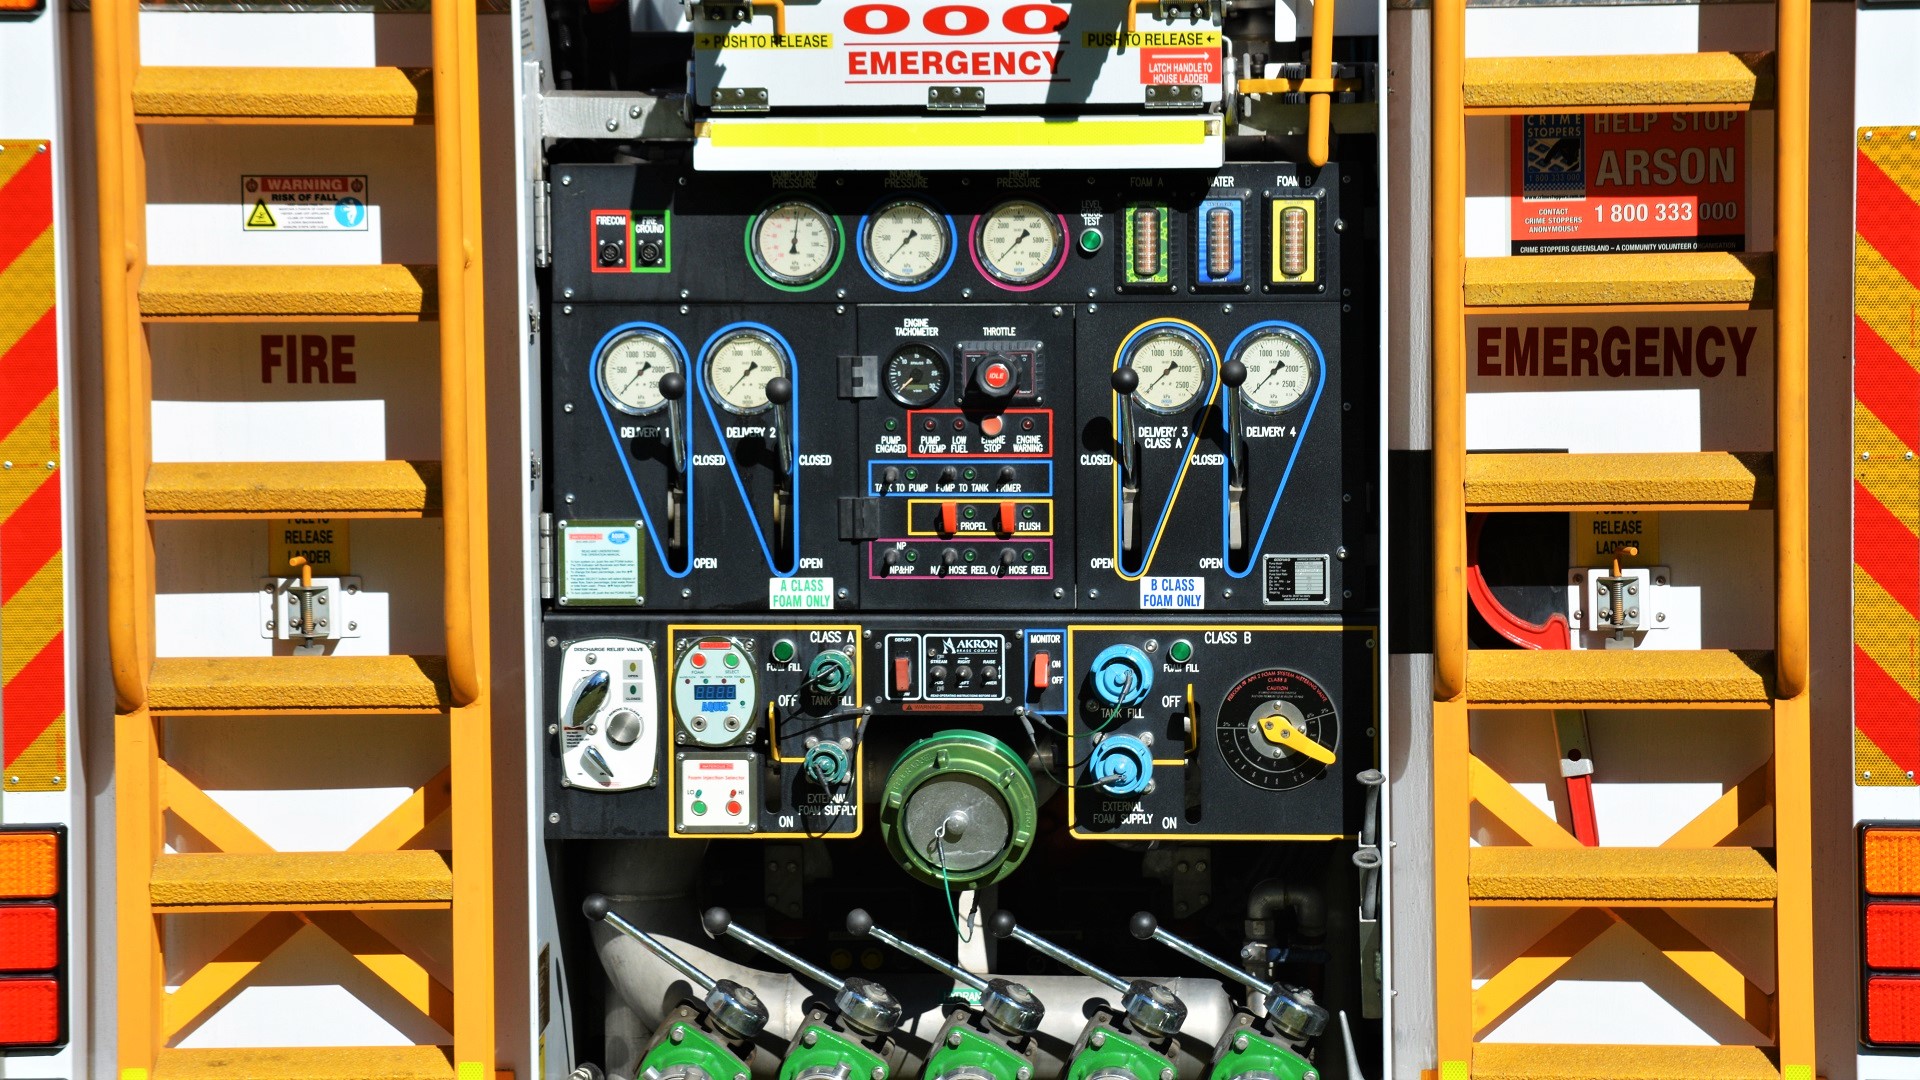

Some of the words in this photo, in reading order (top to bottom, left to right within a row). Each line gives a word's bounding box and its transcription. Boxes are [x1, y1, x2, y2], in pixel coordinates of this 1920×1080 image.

[714, 34, 747, 48] PUSH
[751, 34, 765, 48] TO
[771, 34, 828, 48] RELEASE
[1088, 33, 1122, 47] PUSH
[1124, 33, 1141, 46] TO
[1145, 33, 1204, 47] RELEASE
[848, 50, 1065, 76] EMERGENCY
[1149, 62, 1173, 73] LATCH
[1174, 62, 1203, 73] HANDLE
[1204, 62, 1213, 72] TO
[1153, 74, 1178, 84] HOUSE
[1180, 74, 1208, 84] LADDER
[1527, 114, 1581, 126] CRIME
[1594, 112, 1658, 134] HELP
[1672, 110, 1738, 132] STOP
[1528, 127, 1581, 138] STOPPERS
[1595, 147, 1735, 186] ARSON
[268, 179, 342, 191] WARNING
[772, 179, 817, 189] PRESSURE
[885, 178, 929, 189] PRESSURE
[996, 178, 1040, 189] PRESSURE
[1130, 176, 1153, 187] FOAM
[1157, 176, 1164, 188] A
[1207, 176, 1234, 187] WATER
[1277, 176, 1298, 187] FOAM
[1305, 176, 1312, 187] B
[271, 194, 295, 202] RISK
[298, 194, 311, 202] OF
[314, 194, 338, 202] FALL
[1081, 200, 1100, 209] LEVEL
[1538, 208, 1568, 216] CONTACT
[1595, 205, 1604, 222] 1
[1610, 204, 1648, 222] 800
[1655, 203, 1692, 221] 333
[1700, 202, 1737, 219] 000
[596, 216, 626, 226] FIRECOM
[642, 216, 658, 225] FIRE
[1084, 216, 1100, 226] TEST
[1525, 217, 1546, 225] CRIME
[1548, 216, 1582, 225] STOPPERS
[635, 225, 664, 234] GROUND
[1528, 225, 1579, 234] ANONYMOUSLY
[1519, 246, 1538, 254] CRIME
[1539, 245, 1569, 254] STOPPERS
[1570, 244, 1610, 253] QUEENSLAND
[1622, 243, 1657, 252] COMMUNITY
[1658, 243, 1692, 252] VOLUNTEER
[903, 318, 929, 327] ENGINE
[895, 327, 939, 337] TACHOMETER
[982, 327, 1016, 337] THROTTLE
[625, 350, 639, 358] 1000
[642, 350, 656, 358] 1500
[1150, 349, 1164, 357] 1000
[1170, 349, 1184, 357] 1500
[1259, 349, 1272, 357] 1000
[1276, 349, 1290, 357] 1500
[1477, 325, 1757, 378] EMERGENCY
[261, 335, 356, 384] FIRE
[616, 366, 627, 374] 500
[651, 365, 665, 373] 2000
[1142, 365, 1152, 373] 500
[1178, 365, 1192, 373] 2000
[1285, 365, 1298, 373] 2000
[1175, 381, 1189, 389] 2500
[1282, 380, 1296, 388] 2500
[621, 427, 660, 438] DELIVERY
[665, 427, 670, 438] 1
[726, 427, 765, 438] DELIVERY
[770, 427, 776, 438] 2
[1138, 426, 1177, 437] DELIVERY
[1182, 426, 1188, 437] 3
[1246, 426, 1286, 437] DELIVERY
[1290, 426, 1297, 437] 4
[880, 435, 901, 444] PUMP
[920, 435, 940, 444] PUMP
[952, 435, 967, 444] LOW
[981, 436, 1006, 445] ENGINE
[1015, 435, 1041, 444] ENGINE
[1145, 438, 1172, 448] CLASS
[1175, 438, 1182, 448] A
[875, 444, 907, 454] ENGAGED
[950, 444, 968, 454] FUEL
[983, 444, 1002, 453] STOP
[1013, 444, 1043, 453] WARNING
[693, 455, 726, 466] CLOSED
[799, 455, 832, 466] CLOSED
[1080, 454, 1114, 465] CLOSED
[1191, 454, 1224, 465] CLOSED
[896, 483, 906, 493] TO
[908, 483, 929, 493] PUMP
[958, 483, 967, 493] TO
[971, 483, 989, 493] TANK
[960, 521, 988, 531] PROPEL
[1018, 521, 1041, 531] FLUSH
[1593, 520, 1642, 534] RELEASE
[285, 530, 334, 544] RELEASE
[896, 541, 907, 550] NP
[694, 558, 718, 569] OPEN
[800, 558, 823, 569] OPEN
[1090, 557, 1114, 568] OPEN
[1199, 557, 1223, 568] OPEN
[889, 566, 915, 575] NP&HP
[948, 565, 968, 575] HOSE
[970, 565, 988, 575] REEL
[1008, 565, 1028, 575] HOSE
[1030, 565, 1049, 575] REEL
[781, 580, 788, 592] A
[791, 580, 824, 592] CLASS
[1151, 579, 1157, 591] B
[1161, 579, 1194, 591] CLASS
[773, 595, 804, 607] FOAM
[807, 595, 831, 607] ONLY
[1143, 595, 1173, 607] FOAM
[1177, 595, 1201, 607] ONLY
[810, 630, 842, 643] CLASS
[846, 630, 855, 643] A
[1030, 634, 1060, 644] MONITOR
[1204, 631, 1237, 644] CLASS
[1243, 631, 1252, 644] B
[956, 639, 998, 649] AKRON
[788, 663, 803, 672] FILL
[1051, 660, 1061, 669] ON
[1185, 663, 1200, 673] FILL
[1051, 676, 1064, 685] OFF
[778, 694, 798, 707] OFF
[811, 695, 832, 706] TANK
[837, 695, 855, 706] FILL
[1162, 695, 1182, 708] OFF
[1127, 707, 1145, 719] FILL
[798, 805, 821, 816] FOAM
[824, 804, 857, 816] SUPPLY
[1102, 801, 1144, 812] EXTERNAL
[778, 815, 794, 828] ON
[1093, 813, 1116, 824] FOAM
[1121, 813, 1154, 824] SUPPLY
[1161, 816, 1177, 830] ON
